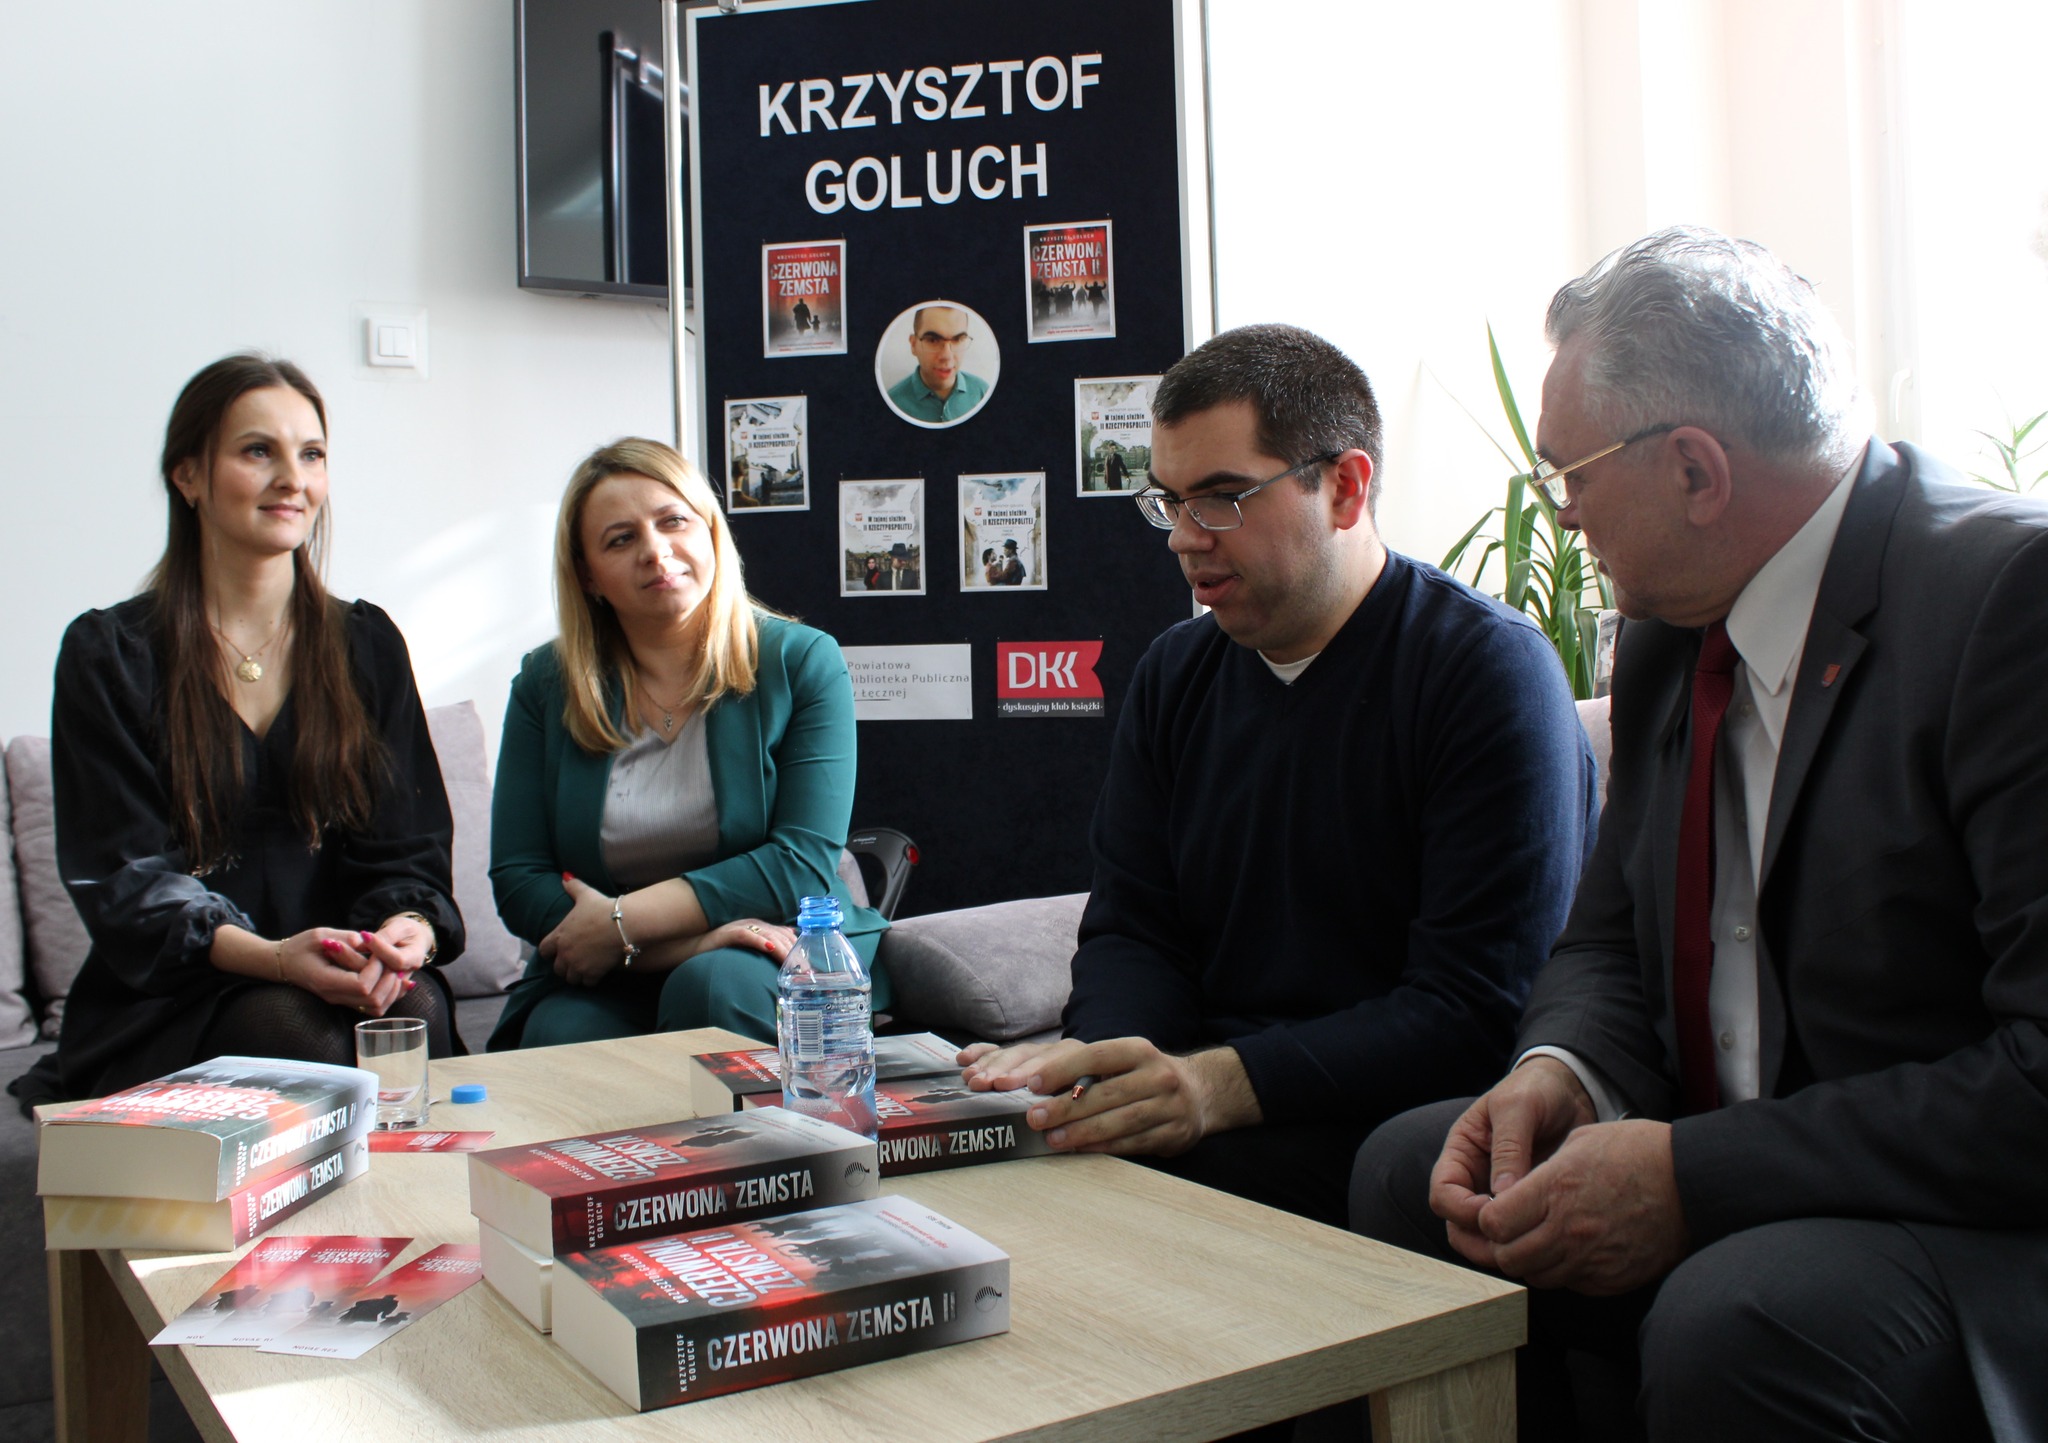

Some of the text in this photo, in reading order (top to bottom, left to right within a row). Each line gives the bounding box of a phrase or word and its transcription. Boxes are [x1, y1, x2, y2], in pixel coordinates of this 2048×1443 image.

[758, 53, 1102, 137] KRZYSZTOF
[805, 143, 1047, 214] GOLUCH
[771, 260, 837, 279] CZERWONA
[1032, 242, 1103, 262] CZERWONA
[1036, 260, 1087, 279] ZEMSTA
[779, 278, 829, 296] ZEMSTA
[847, 661, 911, 670] Powiatowa
[851, 673, 969, 683] iblioteka Publiczna
[1002, 702, 1100, 713] dyskusyjny klub książki
[101, 1096, 269, 1121] CZERWONA
[250, 1123, 308, 1169] CZERWONA
[309, 1106, 347, 1143] ZEMSTA
[597, 1135, 689, 1168] ZEMSTA
[880, 1125, 1016, 1164] RWONA ZEMSTA
[544, 1139, 656, 1182] CZERWONA
[260, 1152, 344, 1220] CZERWONA ZEMSTA
[613, 1169, 814, 1232] CZERWONA ZEMSTA
[587, 1196, 596, 1248] KRZYSZTOF
[596, 1202, 604, 1239] GOLUCH
[637, 1237, 757, 1307] CZERWONA
[704, 1240, 806, 1294] ZEMSTA
[707, 1291, 957, 1371] CZERWONA ZEMSTA II
[676, 1334, 687, 1392] KRZYSZTOF
[687, 1340, 696, 1381] GOLUCH
